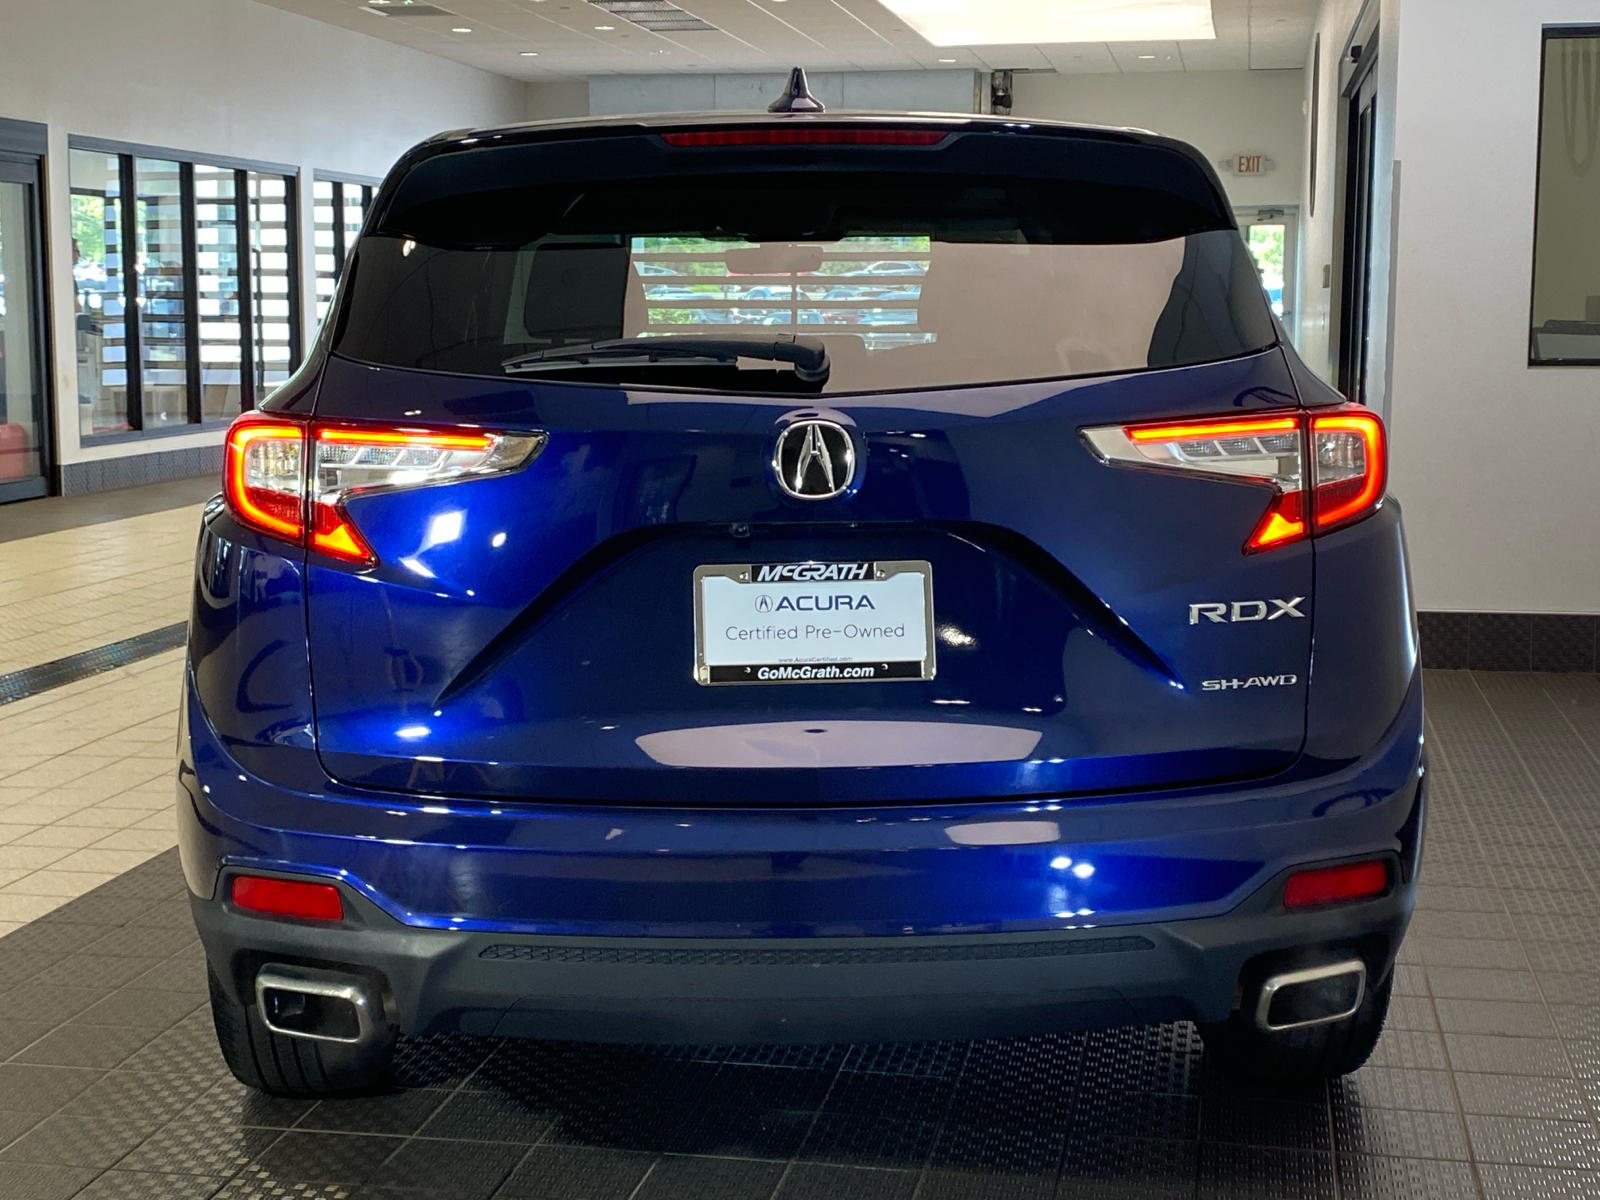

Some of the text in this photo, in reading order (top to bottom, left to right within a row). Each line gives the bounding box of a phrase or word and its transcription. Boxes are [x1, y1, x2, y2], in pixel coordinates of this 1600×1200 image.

[1238, 155, 1261, 173] EXIT
[775, 594, 876, 612] ACURA
[1188, 596, 1306, 625] RDX
[725, 623, 905, 641] Certified Pre-Owned
[757, 665, 875, 680] GoMcGrath.com
[1201, 674, 1298, 691] SH-AWD
